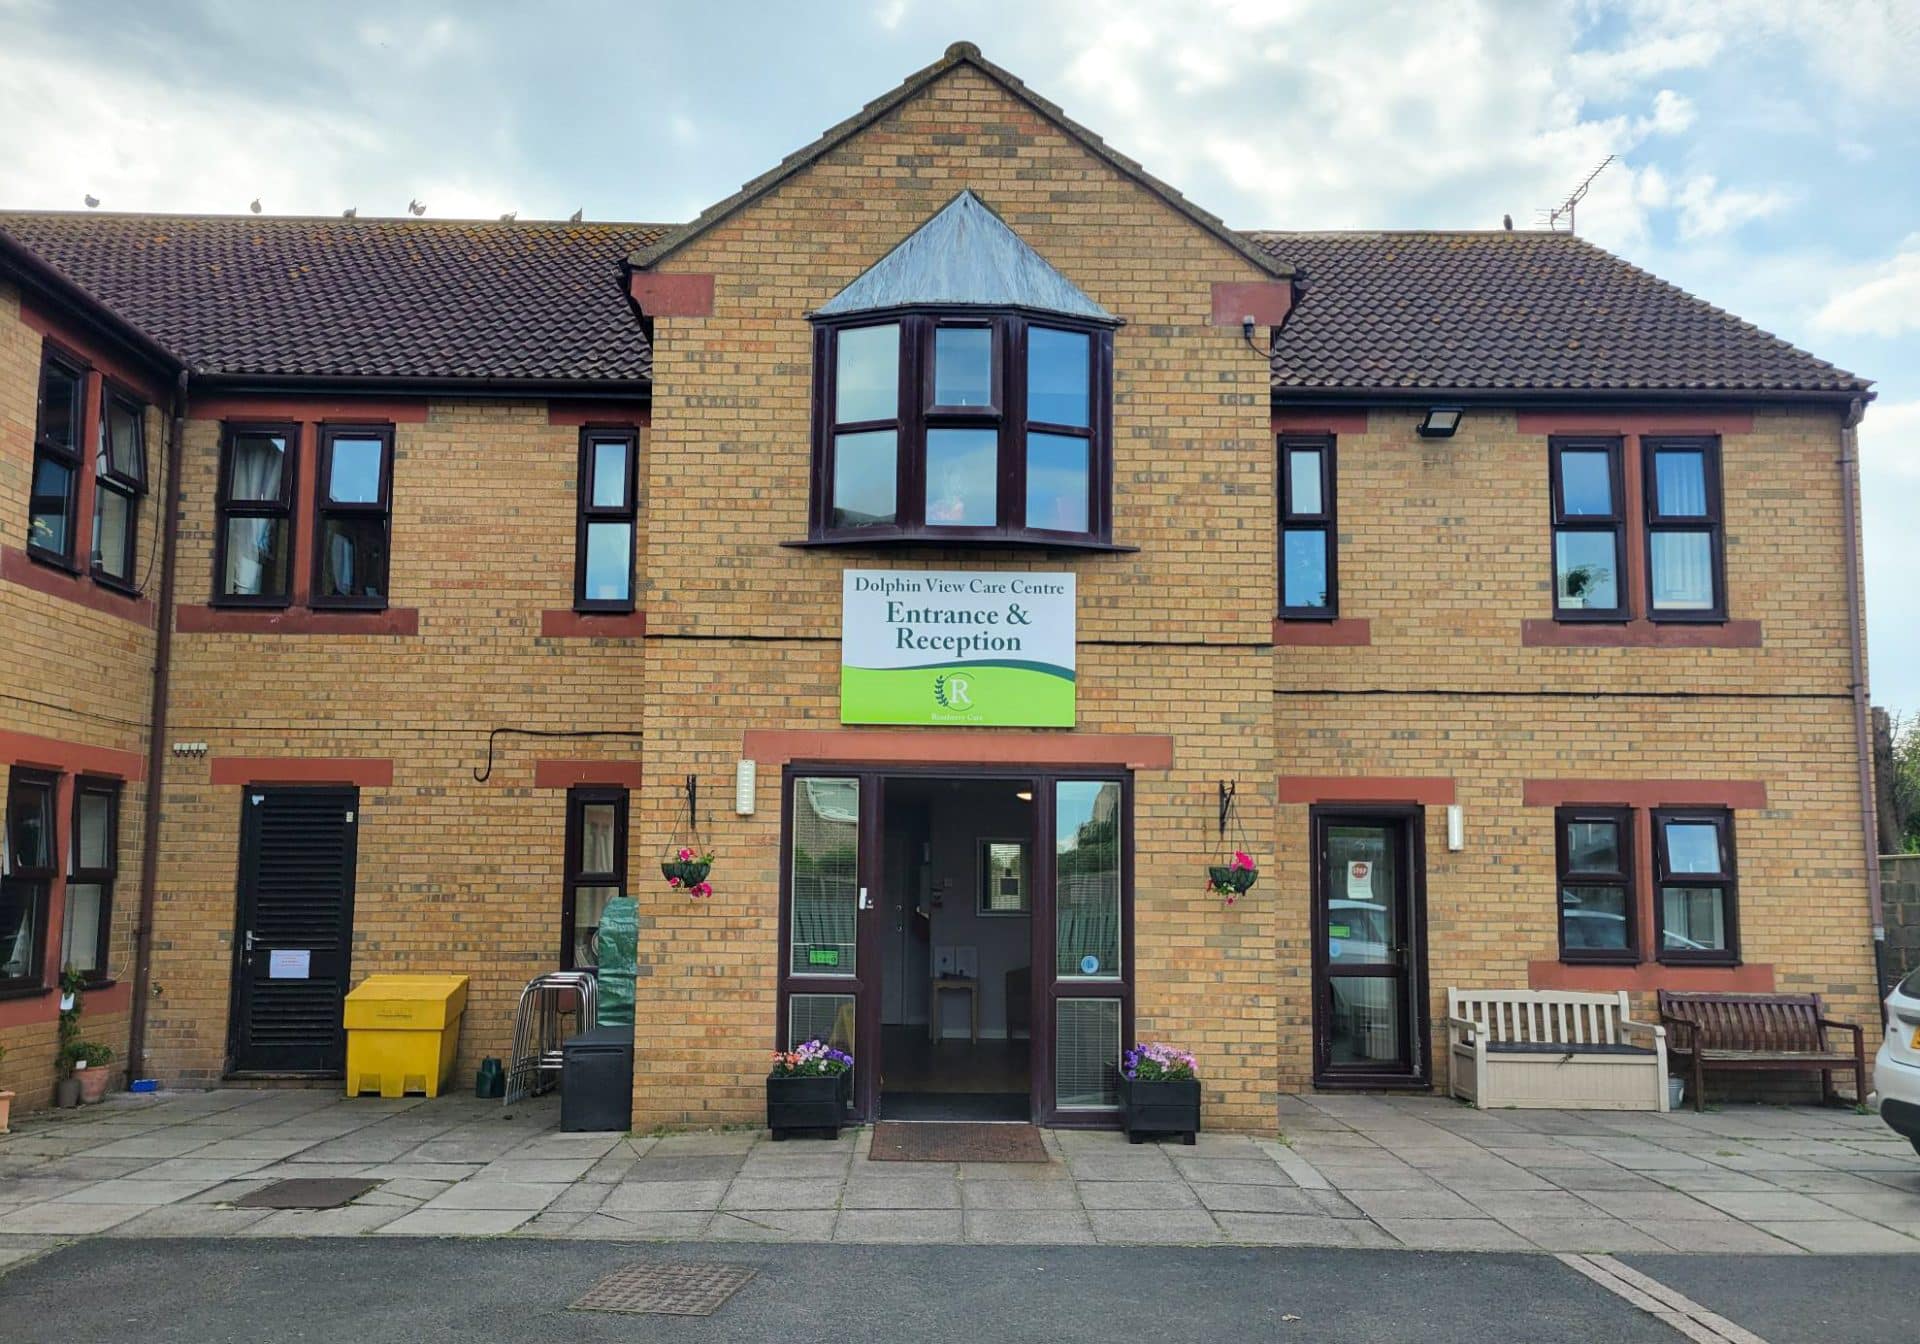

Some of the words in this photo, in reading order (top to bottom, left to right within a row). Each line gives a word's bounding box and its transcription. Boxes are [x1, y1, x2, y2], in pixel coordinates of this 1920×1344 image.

[855, 577, 921, 596] Dolphin
[925, 578, 966, 593] View
[969, 579, 1006, 594] Care
[1010, 579, 1065, 594] Centre
[886, 600, 999, 625] Entrance
[1006, 603, 1033, 625] &
[896, 627, 1022, 657] Reception
[950, 678, 972, 704] R
